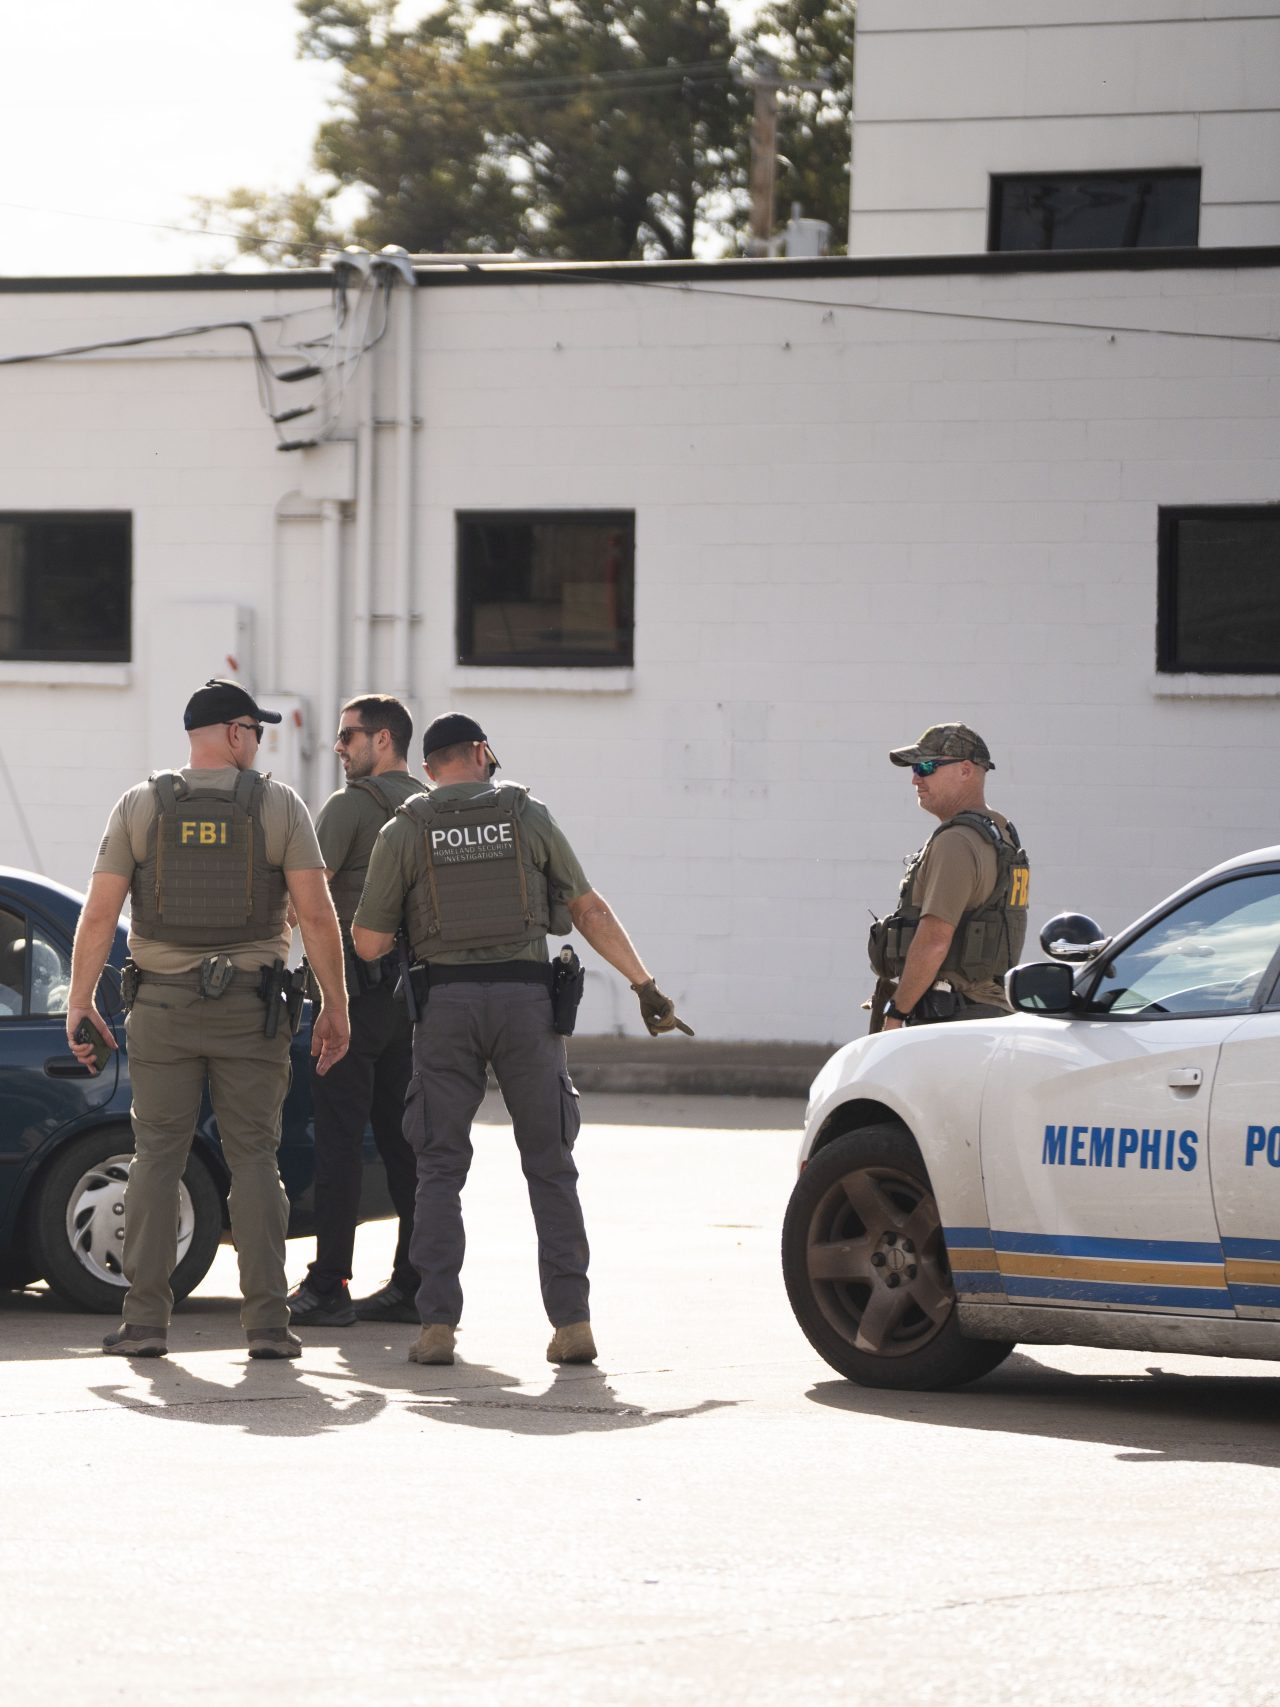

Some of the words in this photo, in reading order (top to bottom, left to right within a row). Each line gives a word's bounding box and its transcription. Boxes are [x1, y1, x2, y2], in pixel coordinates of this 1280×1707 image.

[181, 821, 227, 845] FBI
[431, 822, 513, 849] POLICE
[433, 846, 476, 857] HOMELAND
[477, 842, 513, 852] SECURITY
[444, 850, 504, 863] INVESTIGATIONS
[1010, 868, 1029, 906] FB
[1042, 1125, 1199, 1172] MEMPHIS
